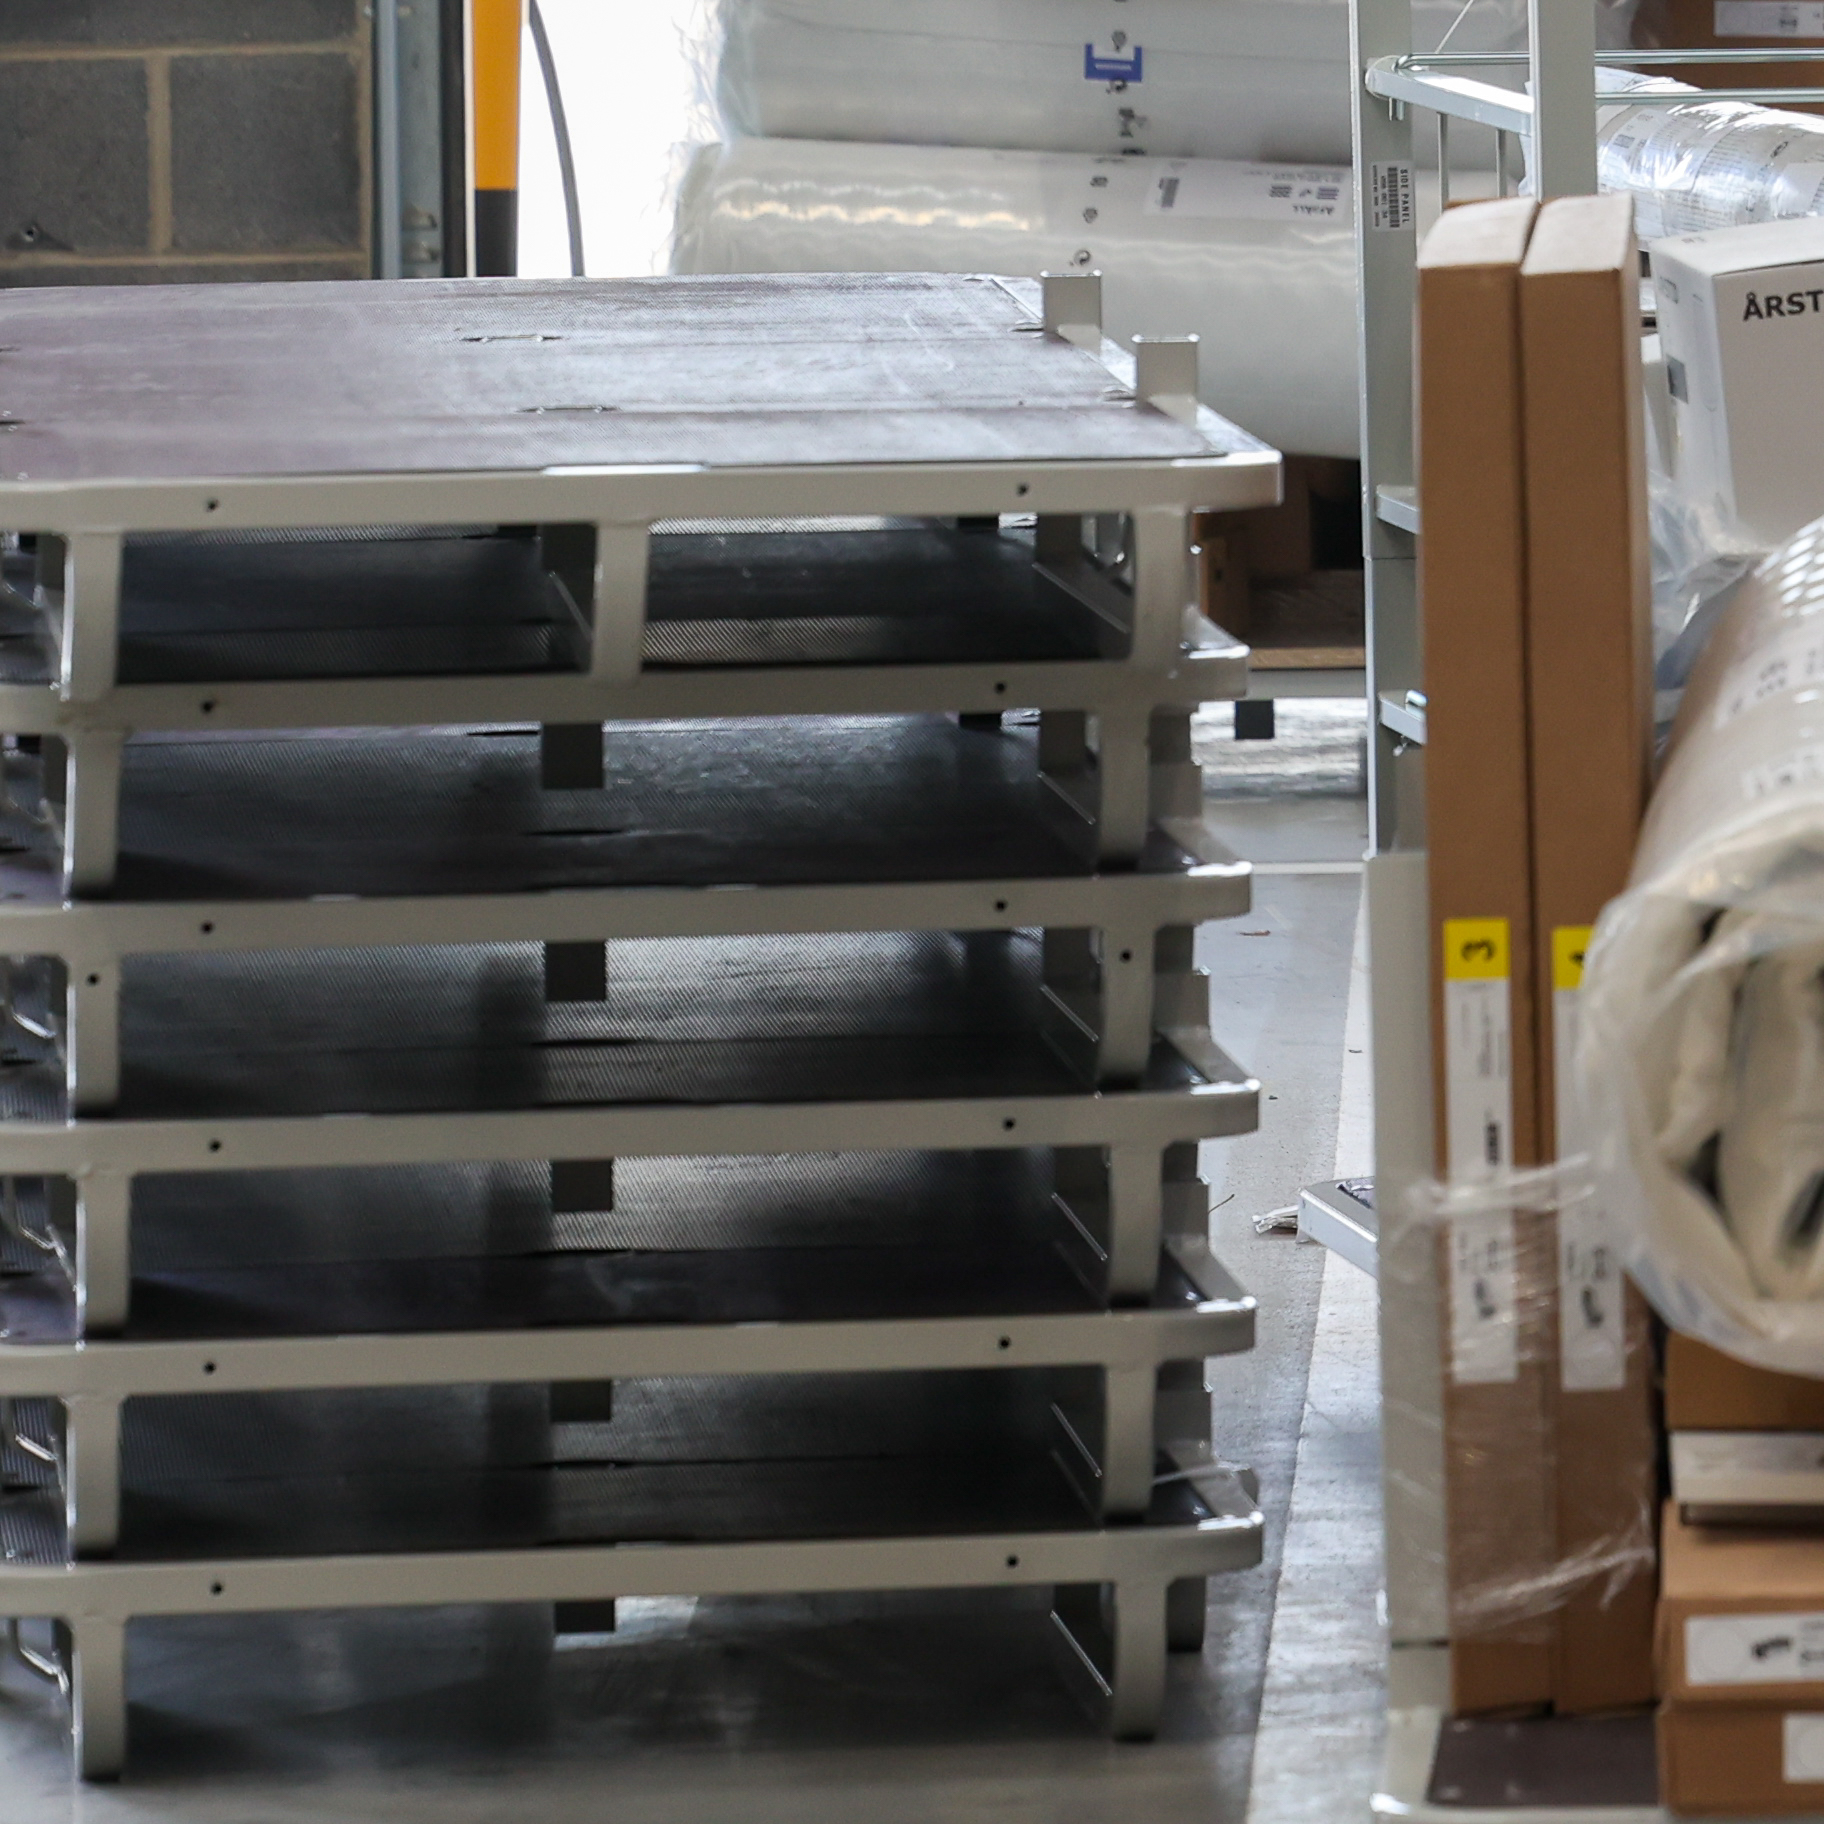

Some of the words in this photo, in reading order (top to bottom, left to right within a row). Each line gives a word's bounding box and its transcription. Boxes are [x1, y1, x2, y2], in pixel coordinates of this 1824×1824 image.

[1399, 169, 1409, 189] SIDE
[1400, 193, 1410, 223] PANEL
[1460, 936, 1497, 964] 3
